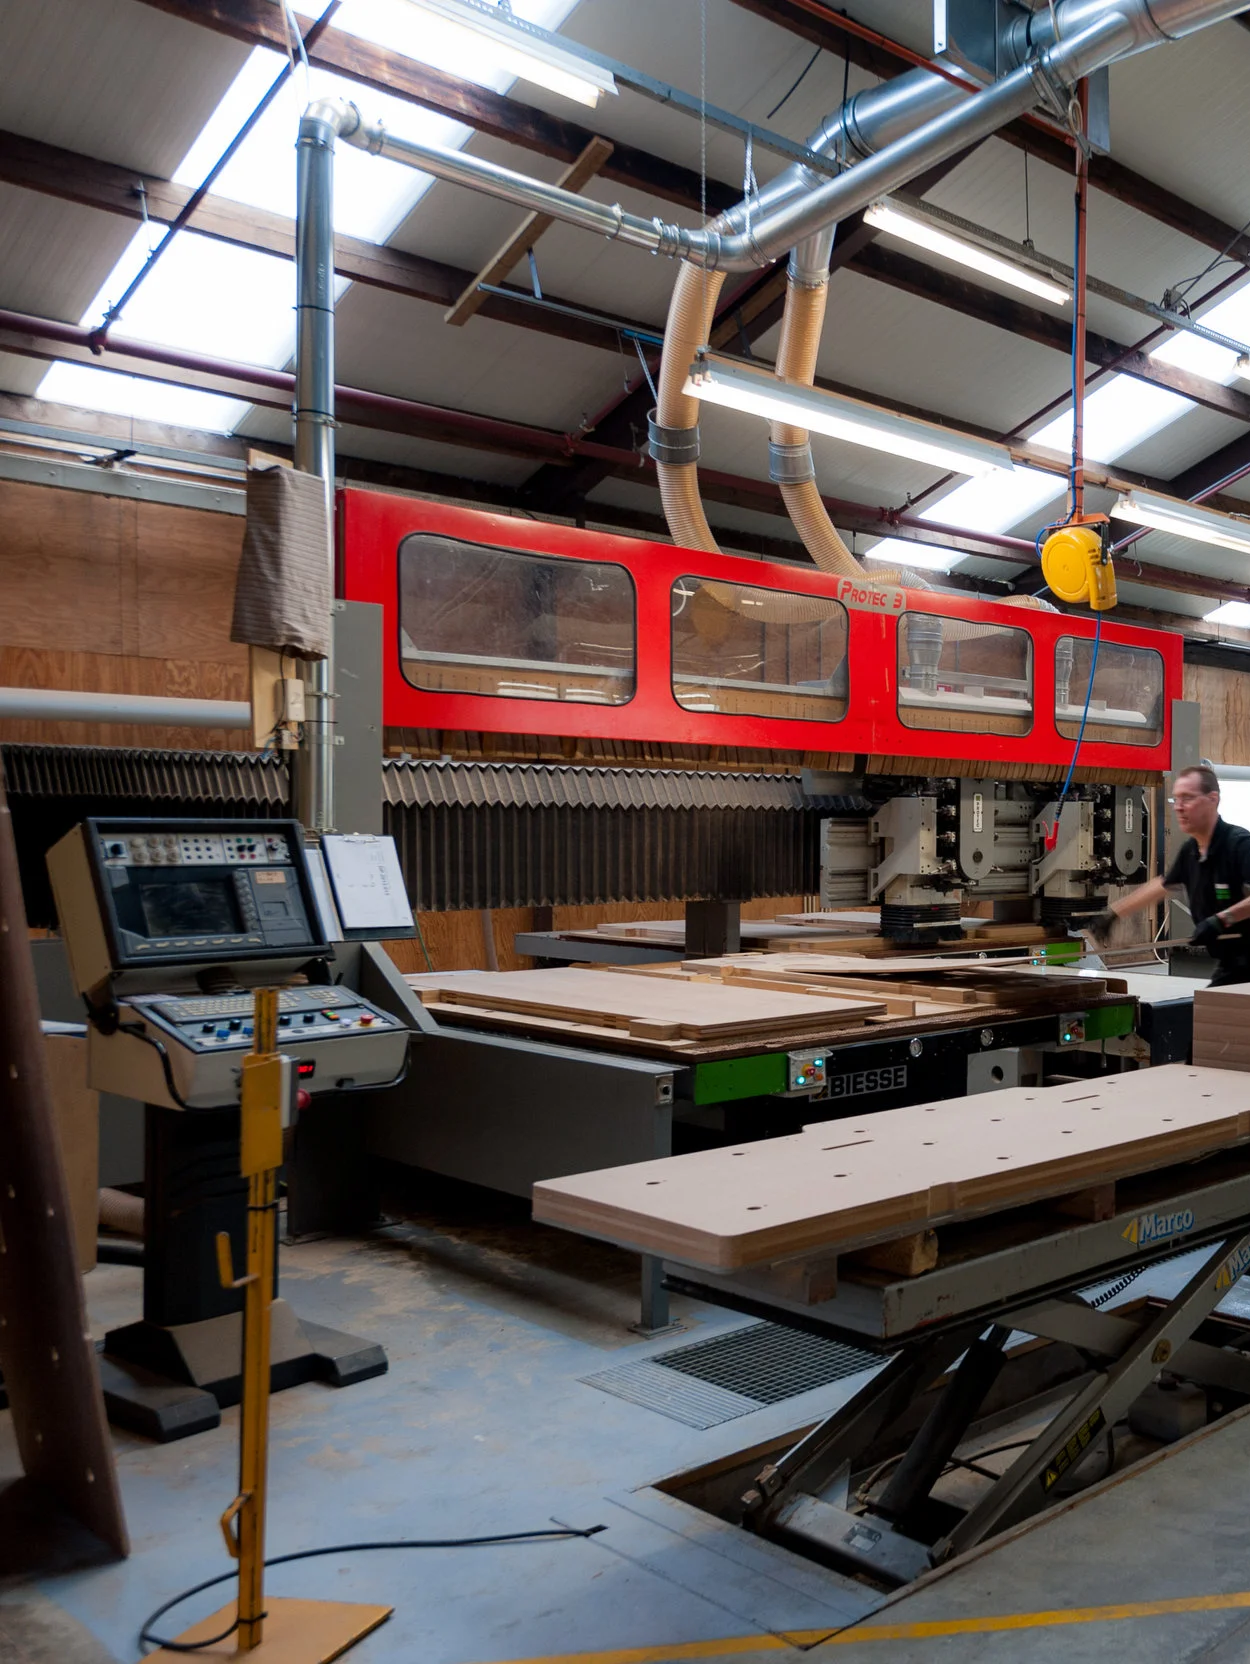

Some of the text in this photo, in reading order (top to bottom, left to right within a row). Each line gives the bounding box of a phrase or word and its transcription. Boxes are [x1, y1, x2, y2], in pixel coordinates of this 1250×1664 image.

[840, 581, 903, 609] PROTEC 3
[831, 1067, 904, 1096] BIESSE
[1139, 1209, 1195, 1244] Marco
